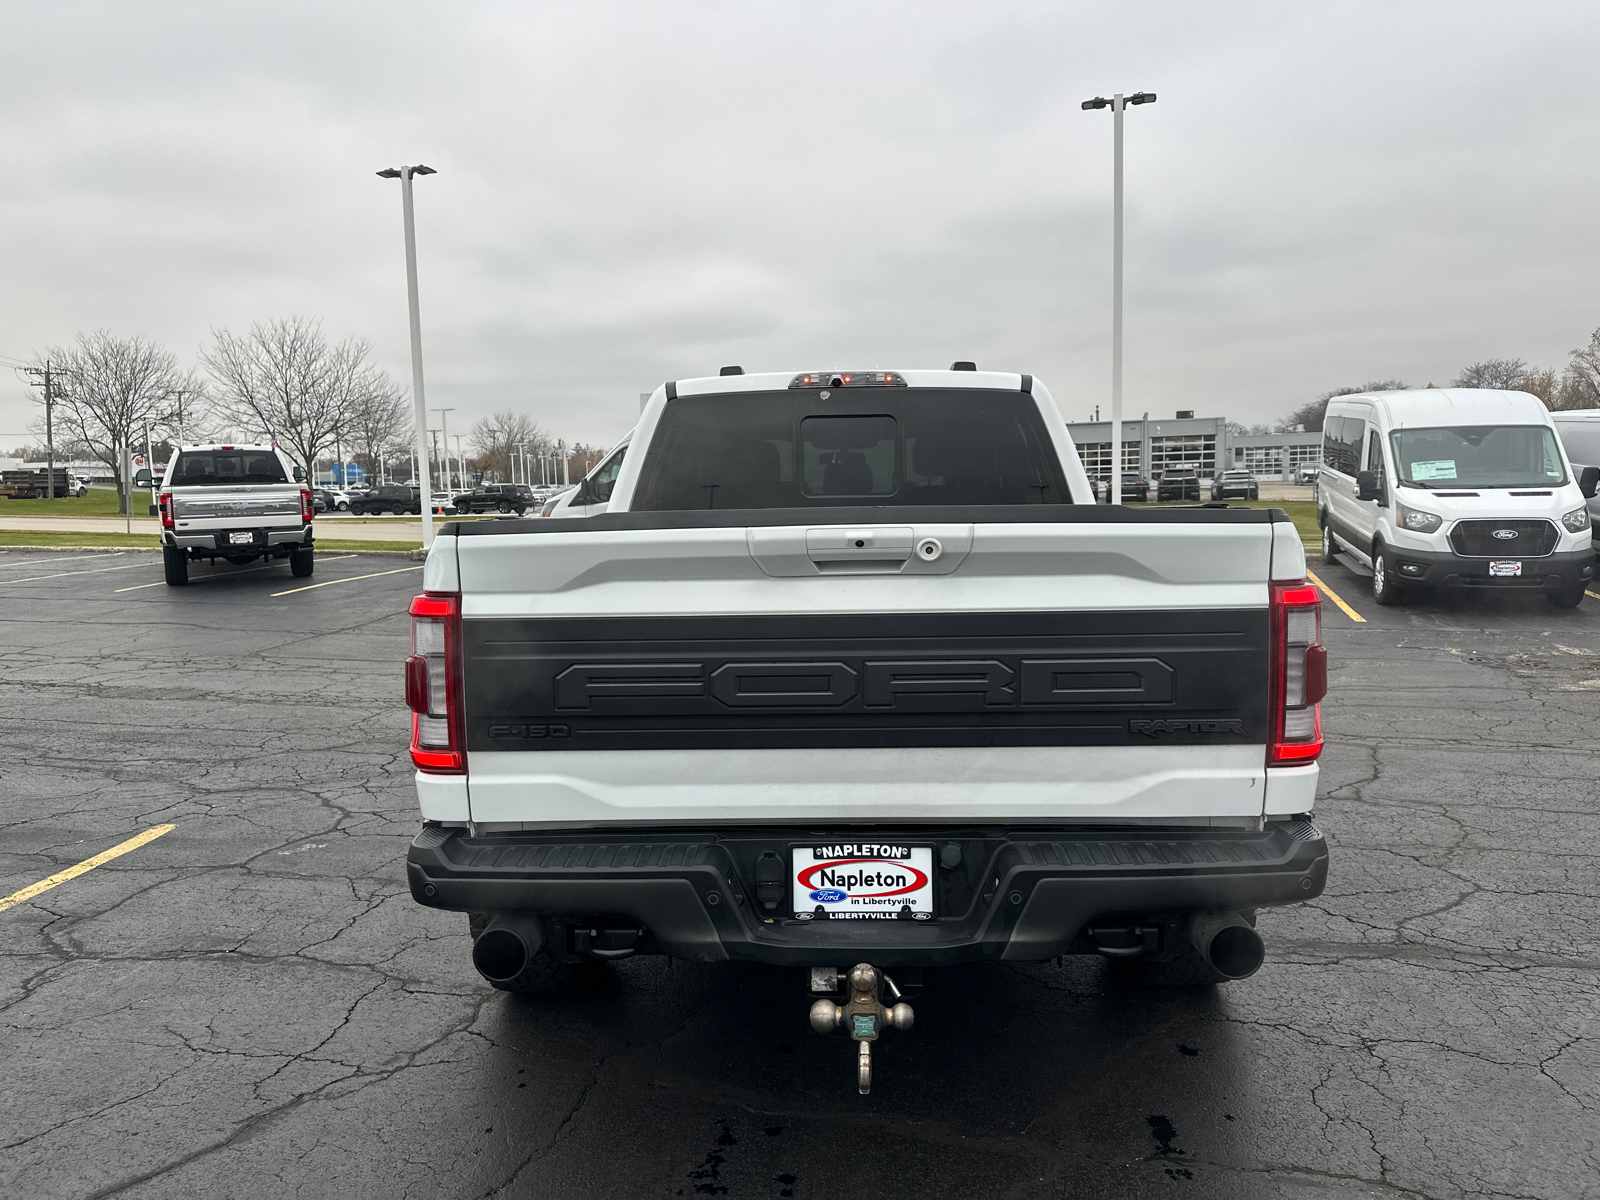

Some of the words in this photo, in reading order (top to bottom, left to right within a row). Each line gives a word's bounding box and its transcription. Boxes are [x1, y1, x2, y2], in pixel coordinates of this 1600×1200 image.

[553, 657, 1177, 711] FORD
[488, 724, 571, 739] F-150
[1128, 718, 1250, 739] RAPTOR
[821, 844, 902, 859] NAPLETON
[820, 869, 907, 892] Napleton
[851, 897, 860, 905] in
[862, 897, 917, 906] Libertyville
[829, 912, 898, 920] LIBERTYVILLE
